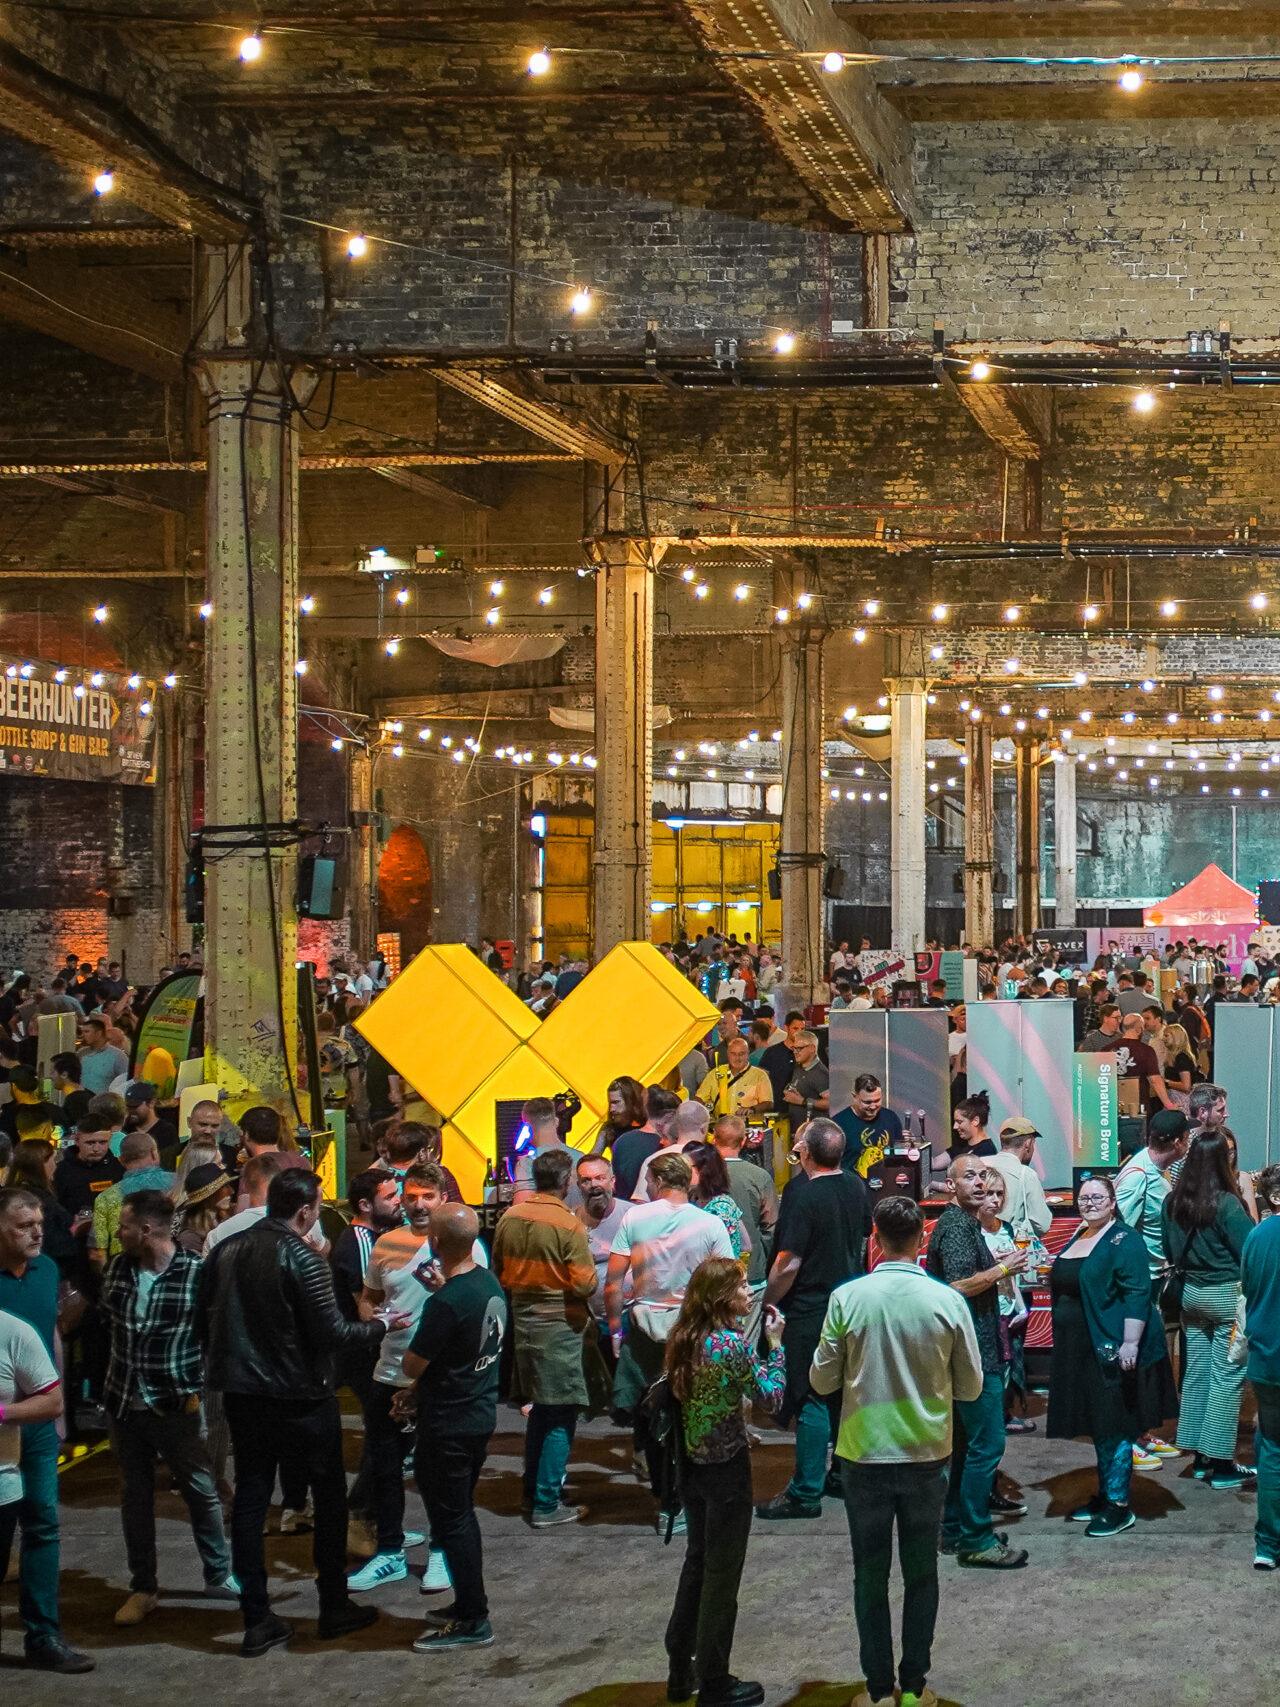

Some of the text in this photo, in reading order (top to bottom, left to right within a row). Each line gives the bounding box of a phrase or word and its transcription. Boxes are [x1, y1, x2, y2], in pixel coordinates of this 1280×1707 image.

[0, 725, 109, 757] OTTLE SHOP & GIN BAR
[1119, 935, 1152, 943] RAISE
[1097, 1064, 1112, 1162] Signature Brew
